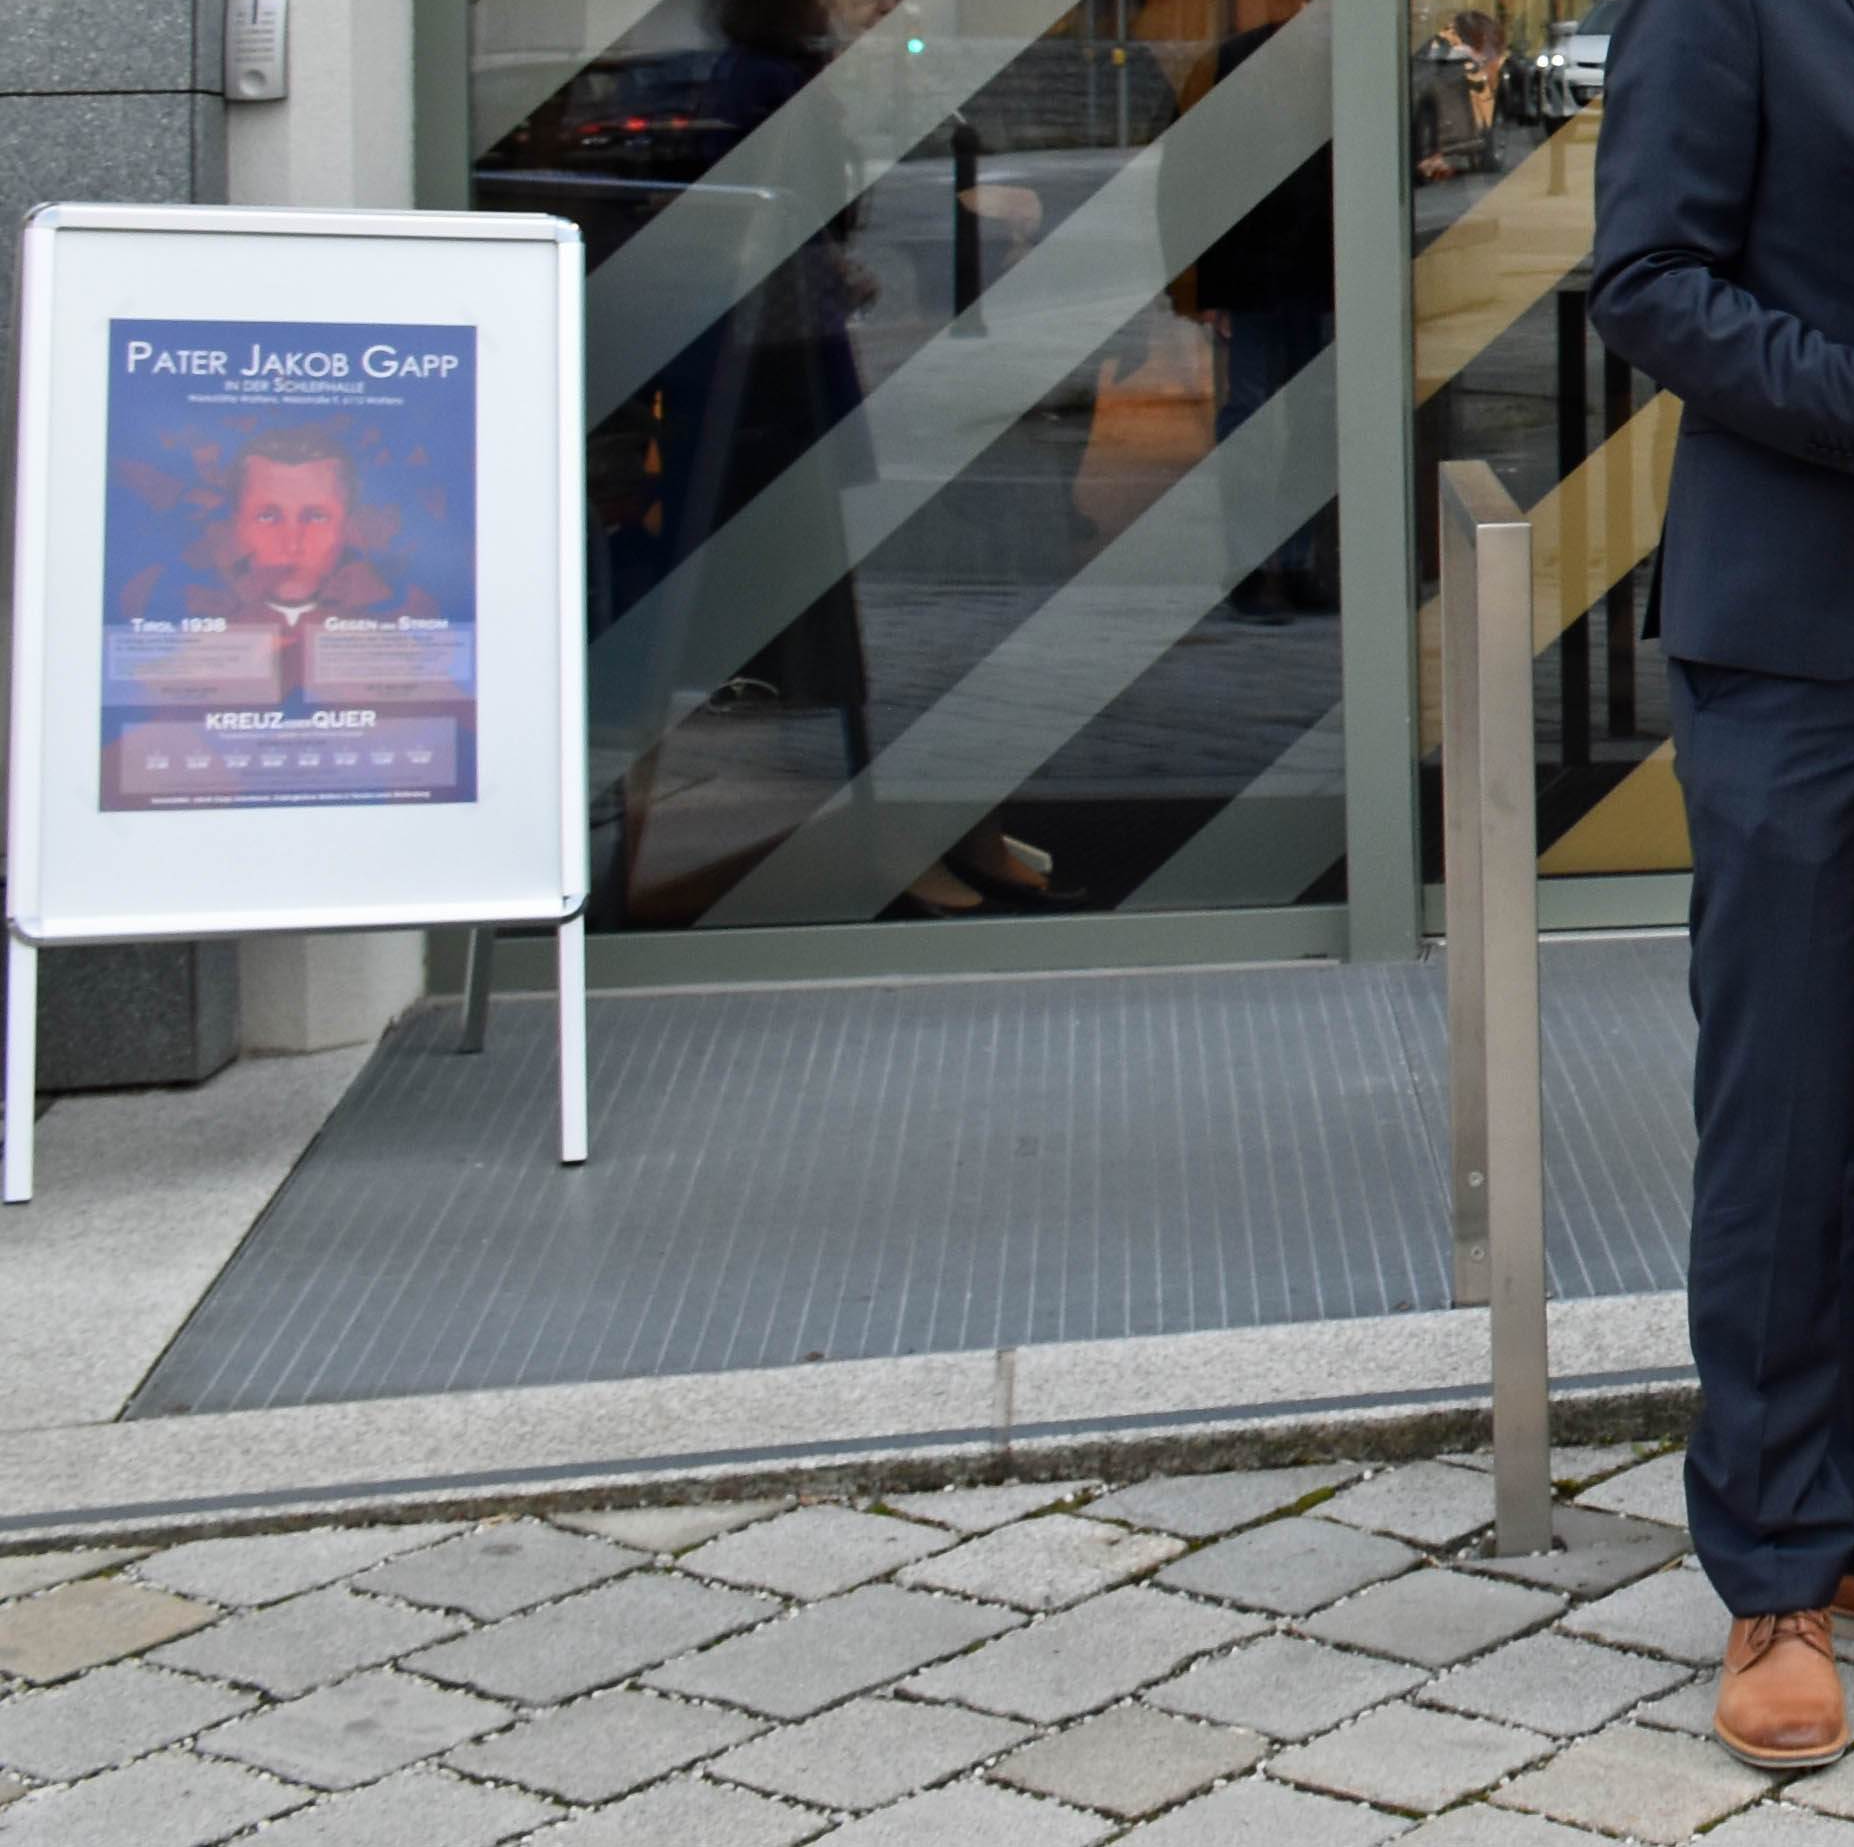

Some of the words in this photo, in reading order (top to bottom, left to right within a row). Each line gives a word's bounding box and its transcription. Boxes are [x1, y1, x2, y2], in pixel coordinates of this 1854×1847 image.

[126, 341, 229, 375] PATER
[240, 343, 350, 377] JAKOB
[362, 345, 459, 378] GAPP
[181, 617, 227, 633] 1938
[206, 711, 284, 730] KREUZ
[312, 710, 376, 729] QUER
